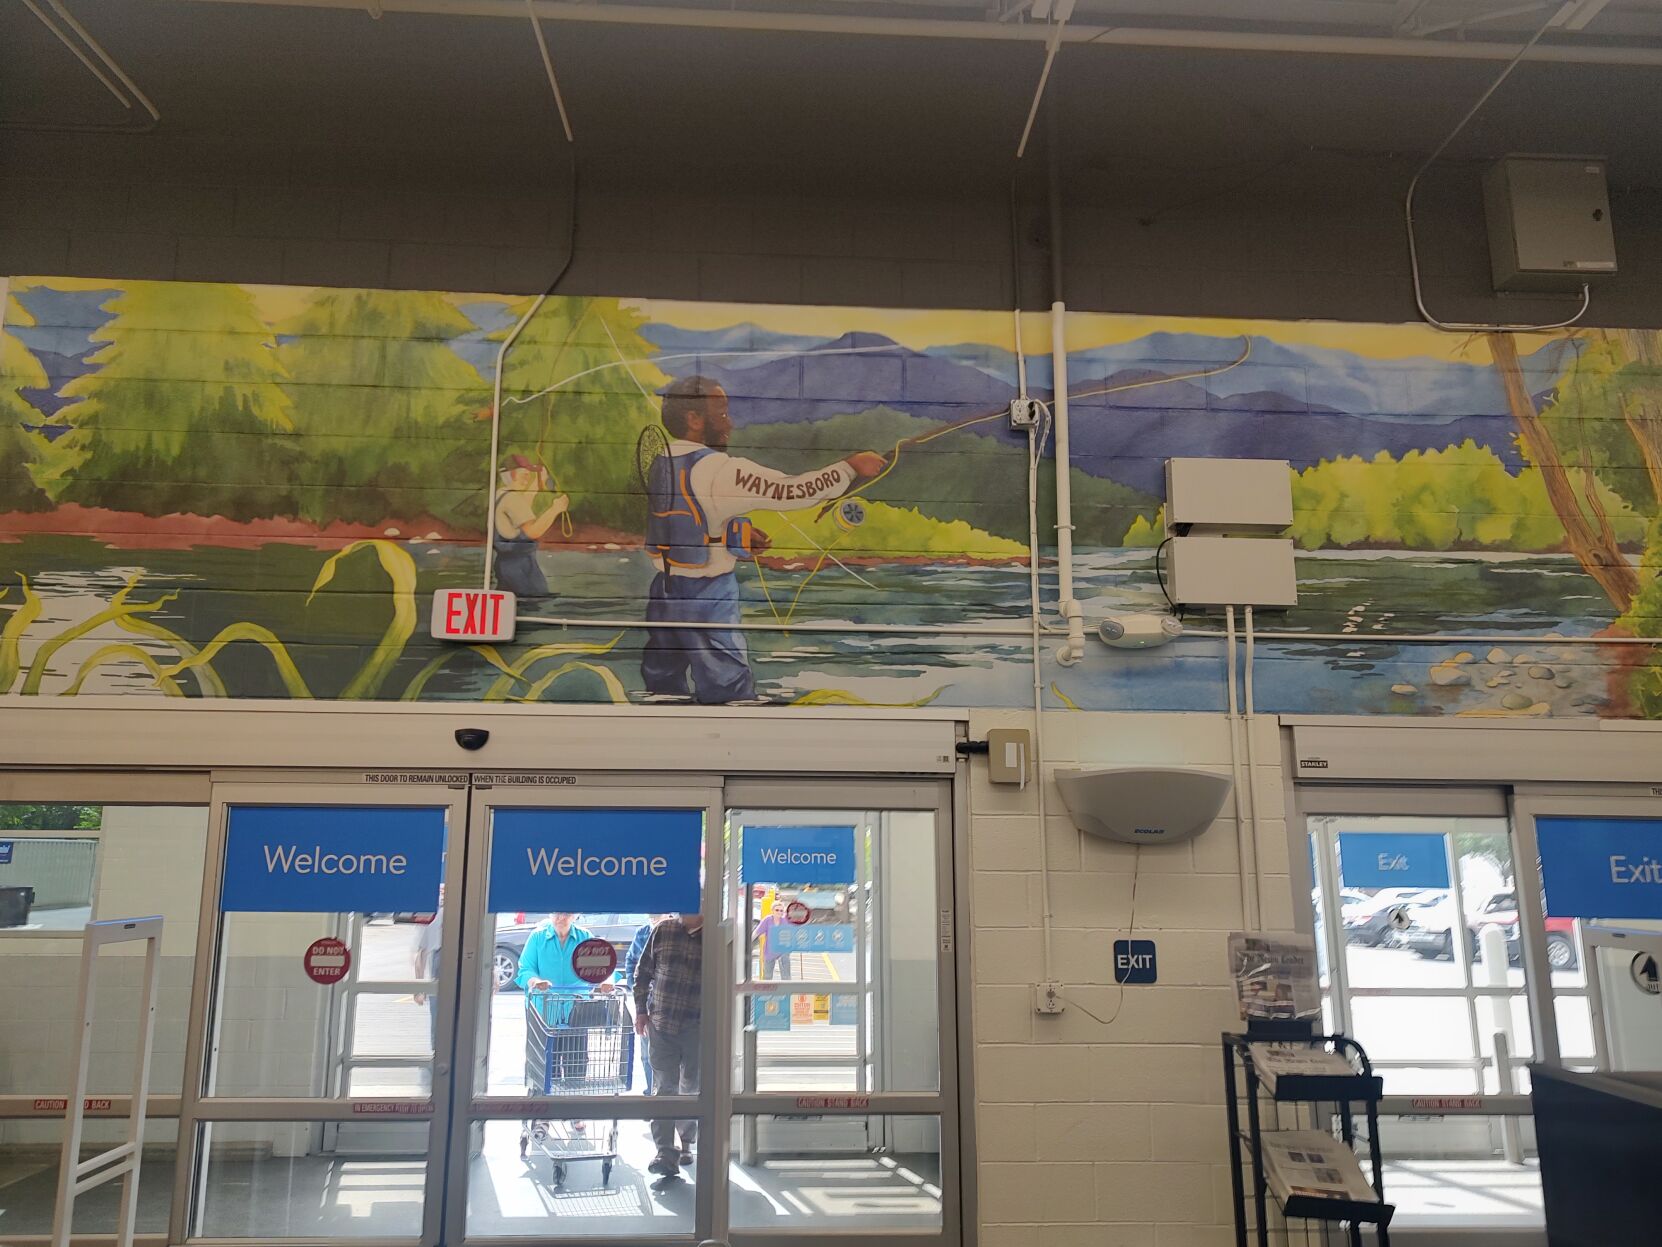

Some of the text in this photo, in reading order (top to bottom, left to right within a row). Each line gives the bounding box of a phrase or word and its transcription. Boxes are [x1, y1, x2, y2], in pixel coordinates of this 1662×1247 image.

[735, 468, 841, 500] WAYNESBORO
[446, 593, 504, 635] EXIT
[365, 774, 468, 783] THIS DOOR TO REMAIN UNLOCKED
[474, 775, 577, 785] WHEN THE BUILDING IS OCCUPIED
[263, 845, 407, 874] Welcome
[526, 847, 668, 876] Welcome
[760, 848, 837, 865] Welcome
[1609, 855, 1662, 883] Exit
[312, 946, 345, 955] DO NOT
[1117, 954, 1152, 969] EXIT
[313, 967, 341, 976] ENTER
[35, 1100, 65, 1109] CAUTION
[91, 1100, 110, 1109] BACK
[362, 1103, 395, 1112] EMERGENCY
